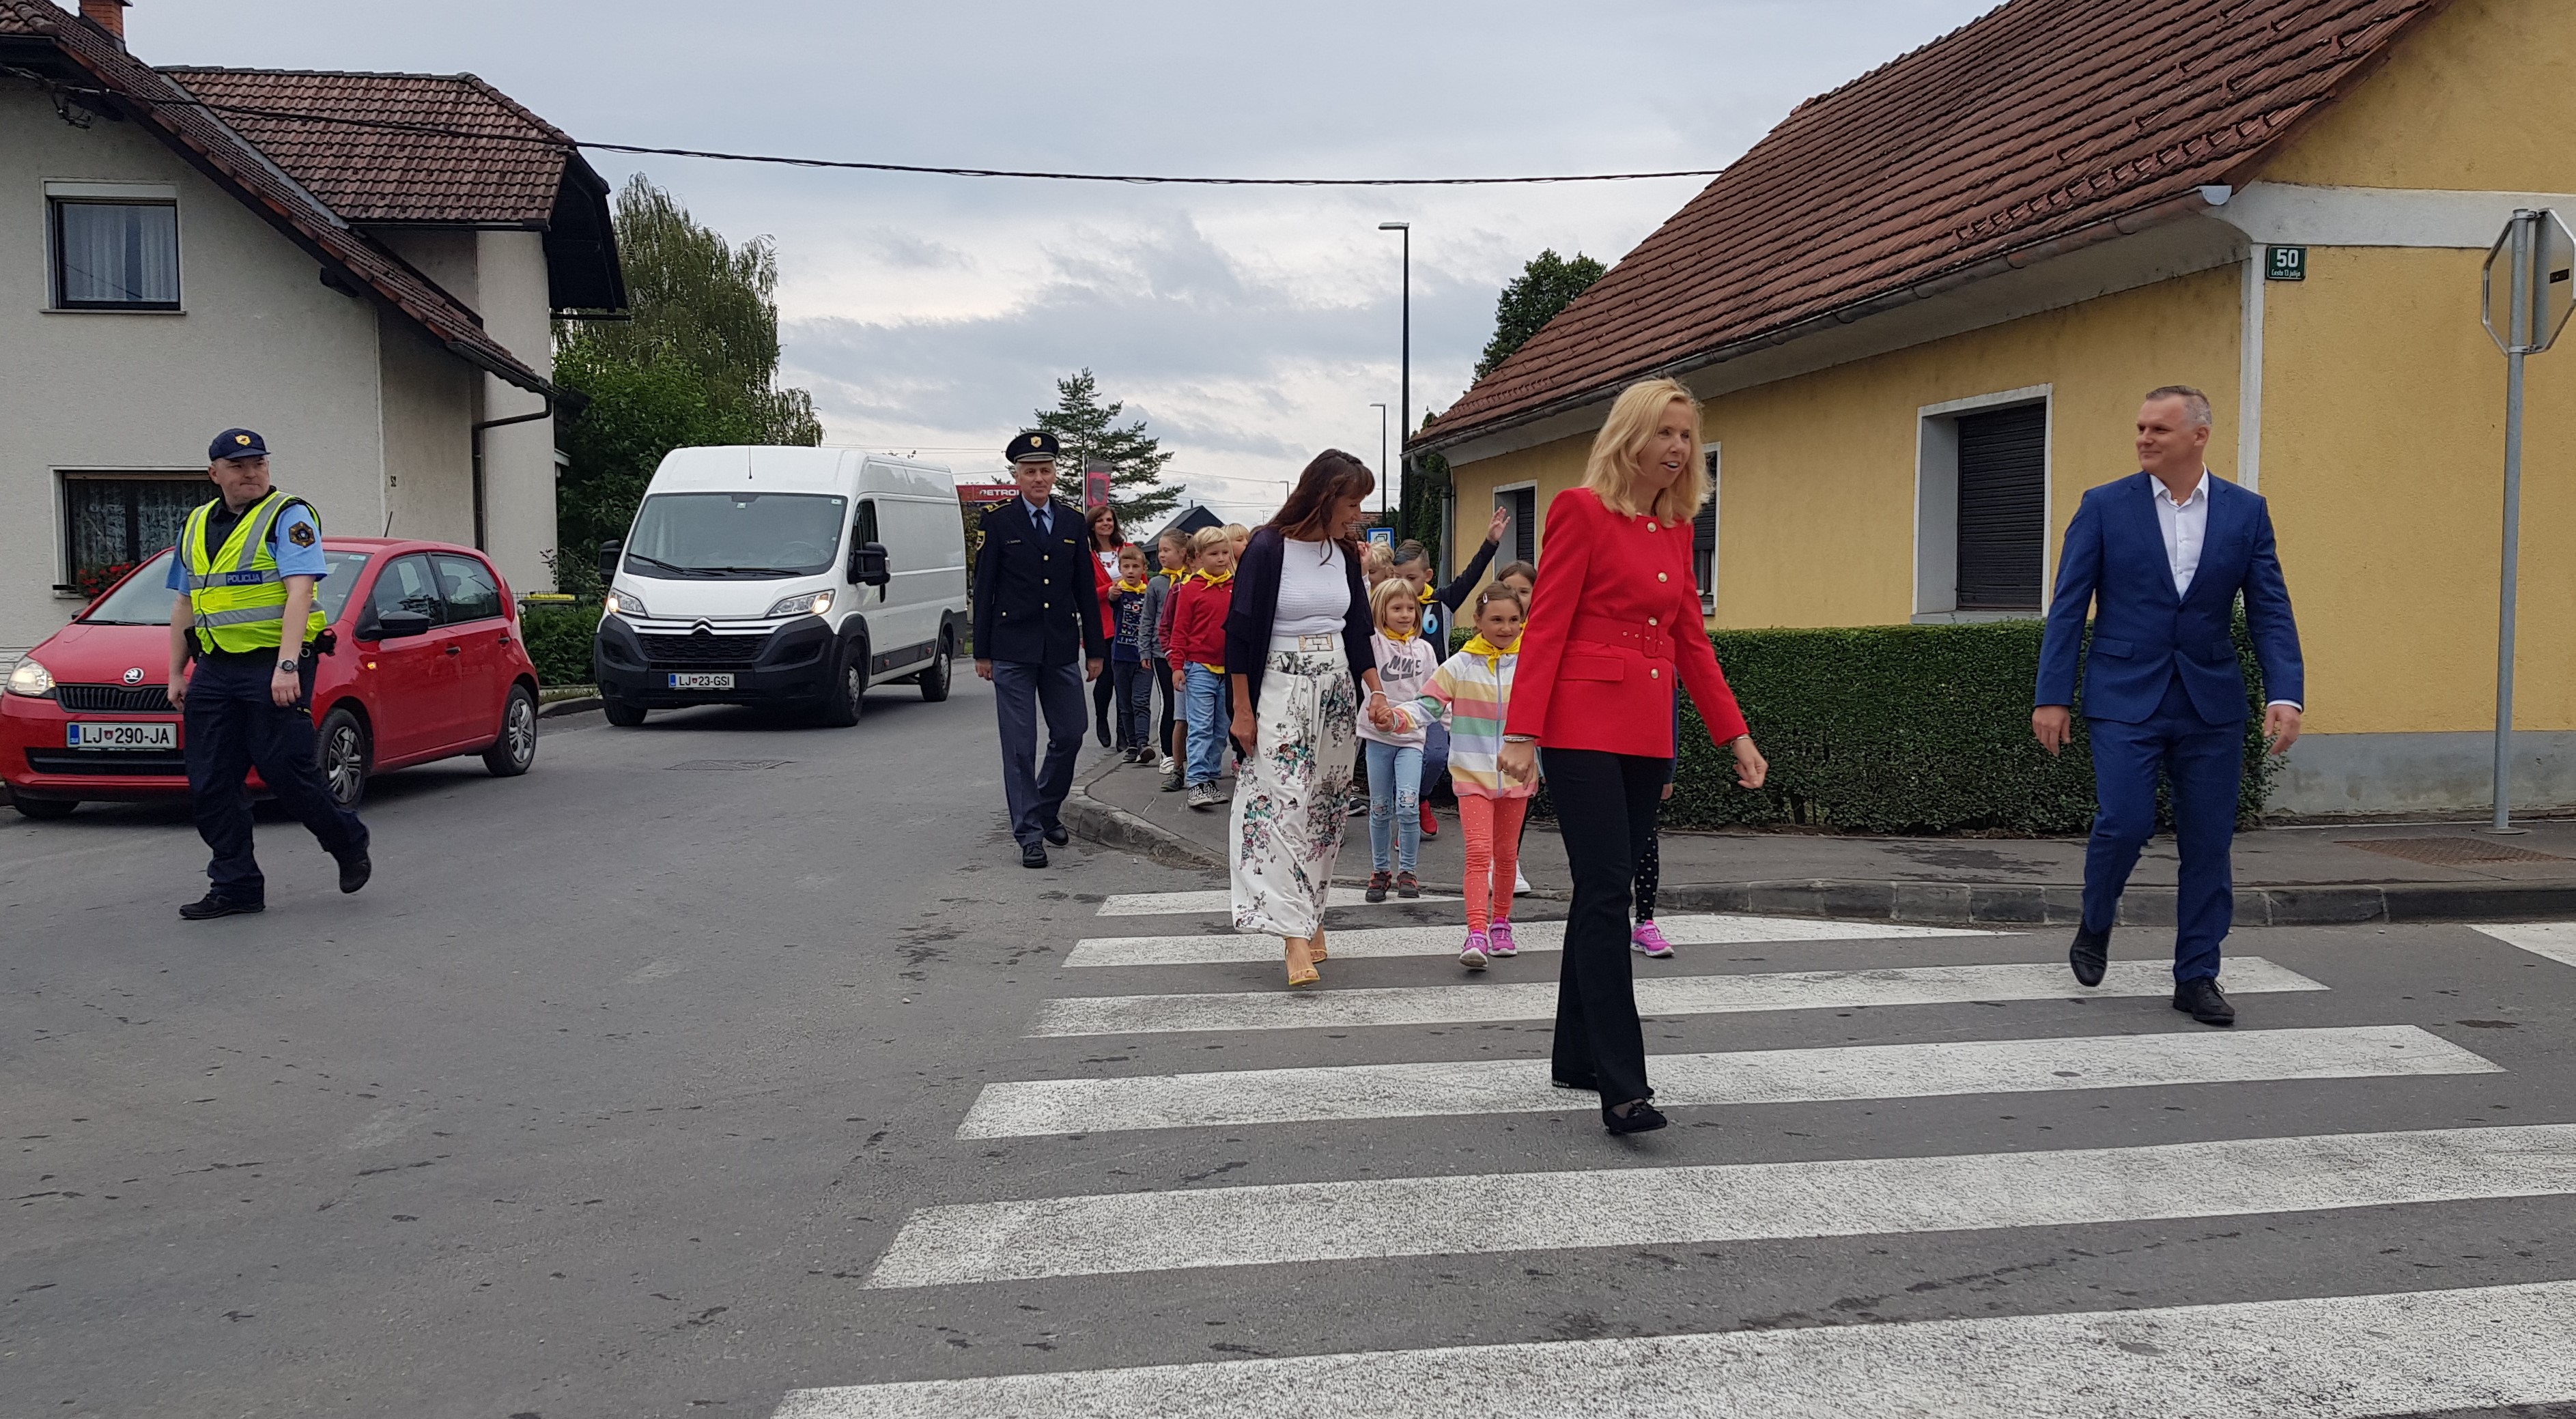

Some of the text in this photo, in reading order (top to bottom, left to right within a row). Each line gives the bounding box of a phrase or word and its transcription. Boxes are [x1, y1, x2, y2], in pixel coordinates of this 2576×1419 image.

[2276, 249, 2299, 267] 50
[227, 573, 261, 584] POLICIJA
[1422, 604, 1438, 634] 6
[1388, 655, 1421, 673] NIKE
[698, 676, 730, 686] 23-GSI
[83, 727, 170, 744] LJ 290-JA
